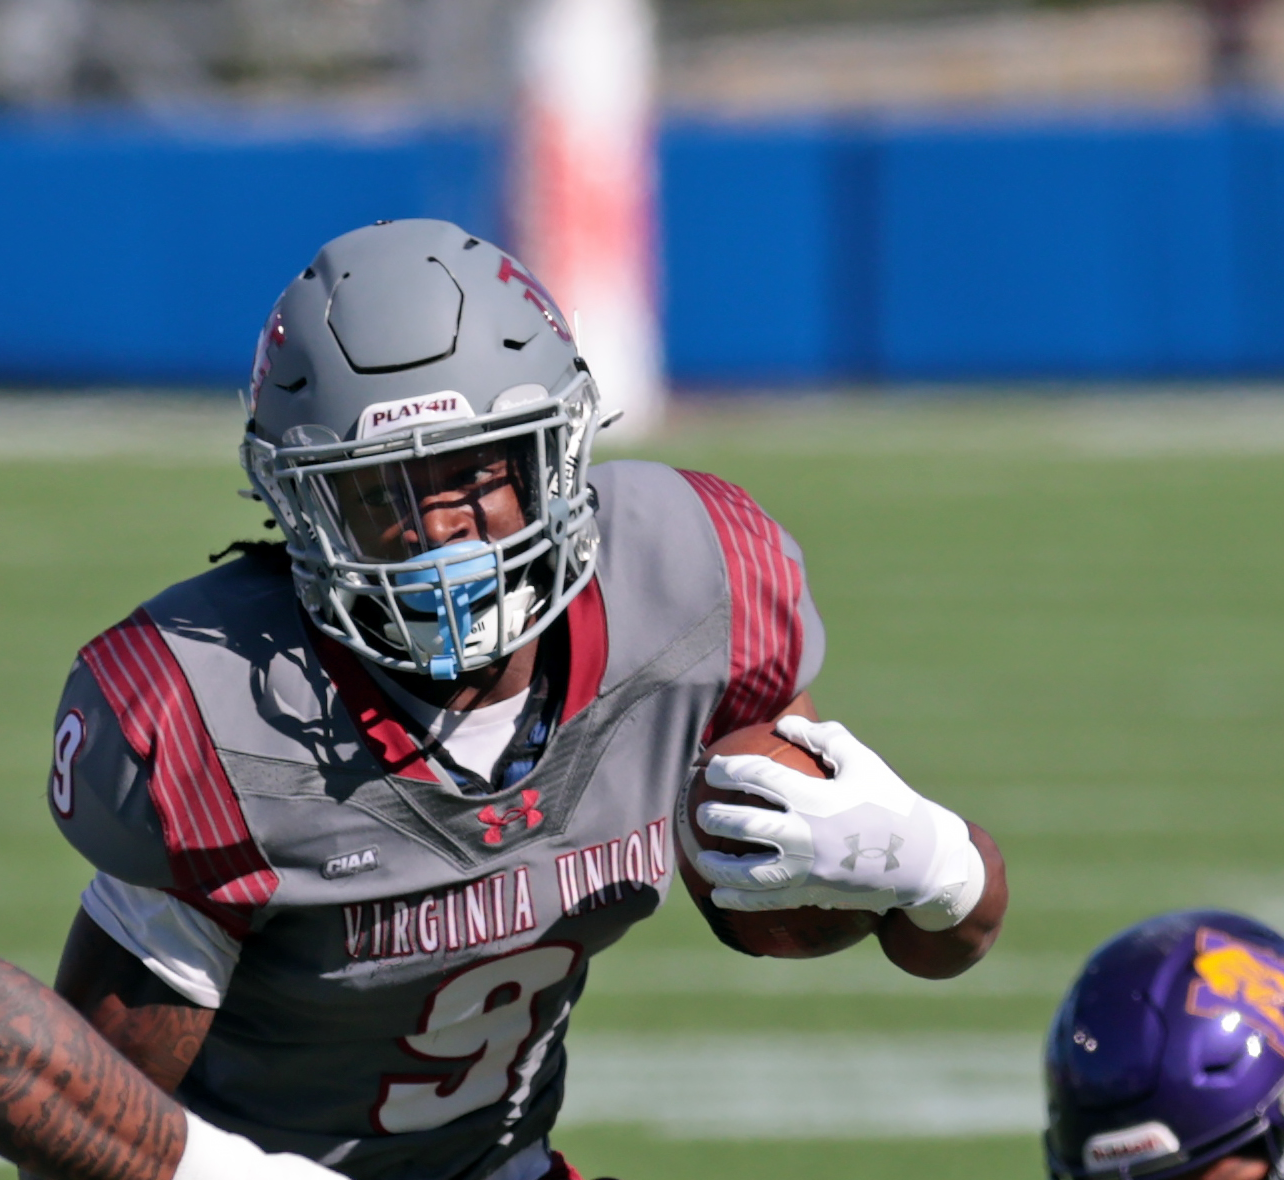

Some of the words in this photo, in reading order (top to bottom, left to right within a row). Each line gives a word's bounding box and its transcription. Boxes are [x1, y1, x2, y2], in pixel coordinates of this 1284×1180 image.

[372, 398, 458, 428] PLAY411
[52, 708, 87, 820] 9
[326, 849, 375, 874] CIAA
[343, 866, 536, 958] VIRGINIA
[555, 817, 667, 918] UNION
[369, 939, 584, 1138] 9
